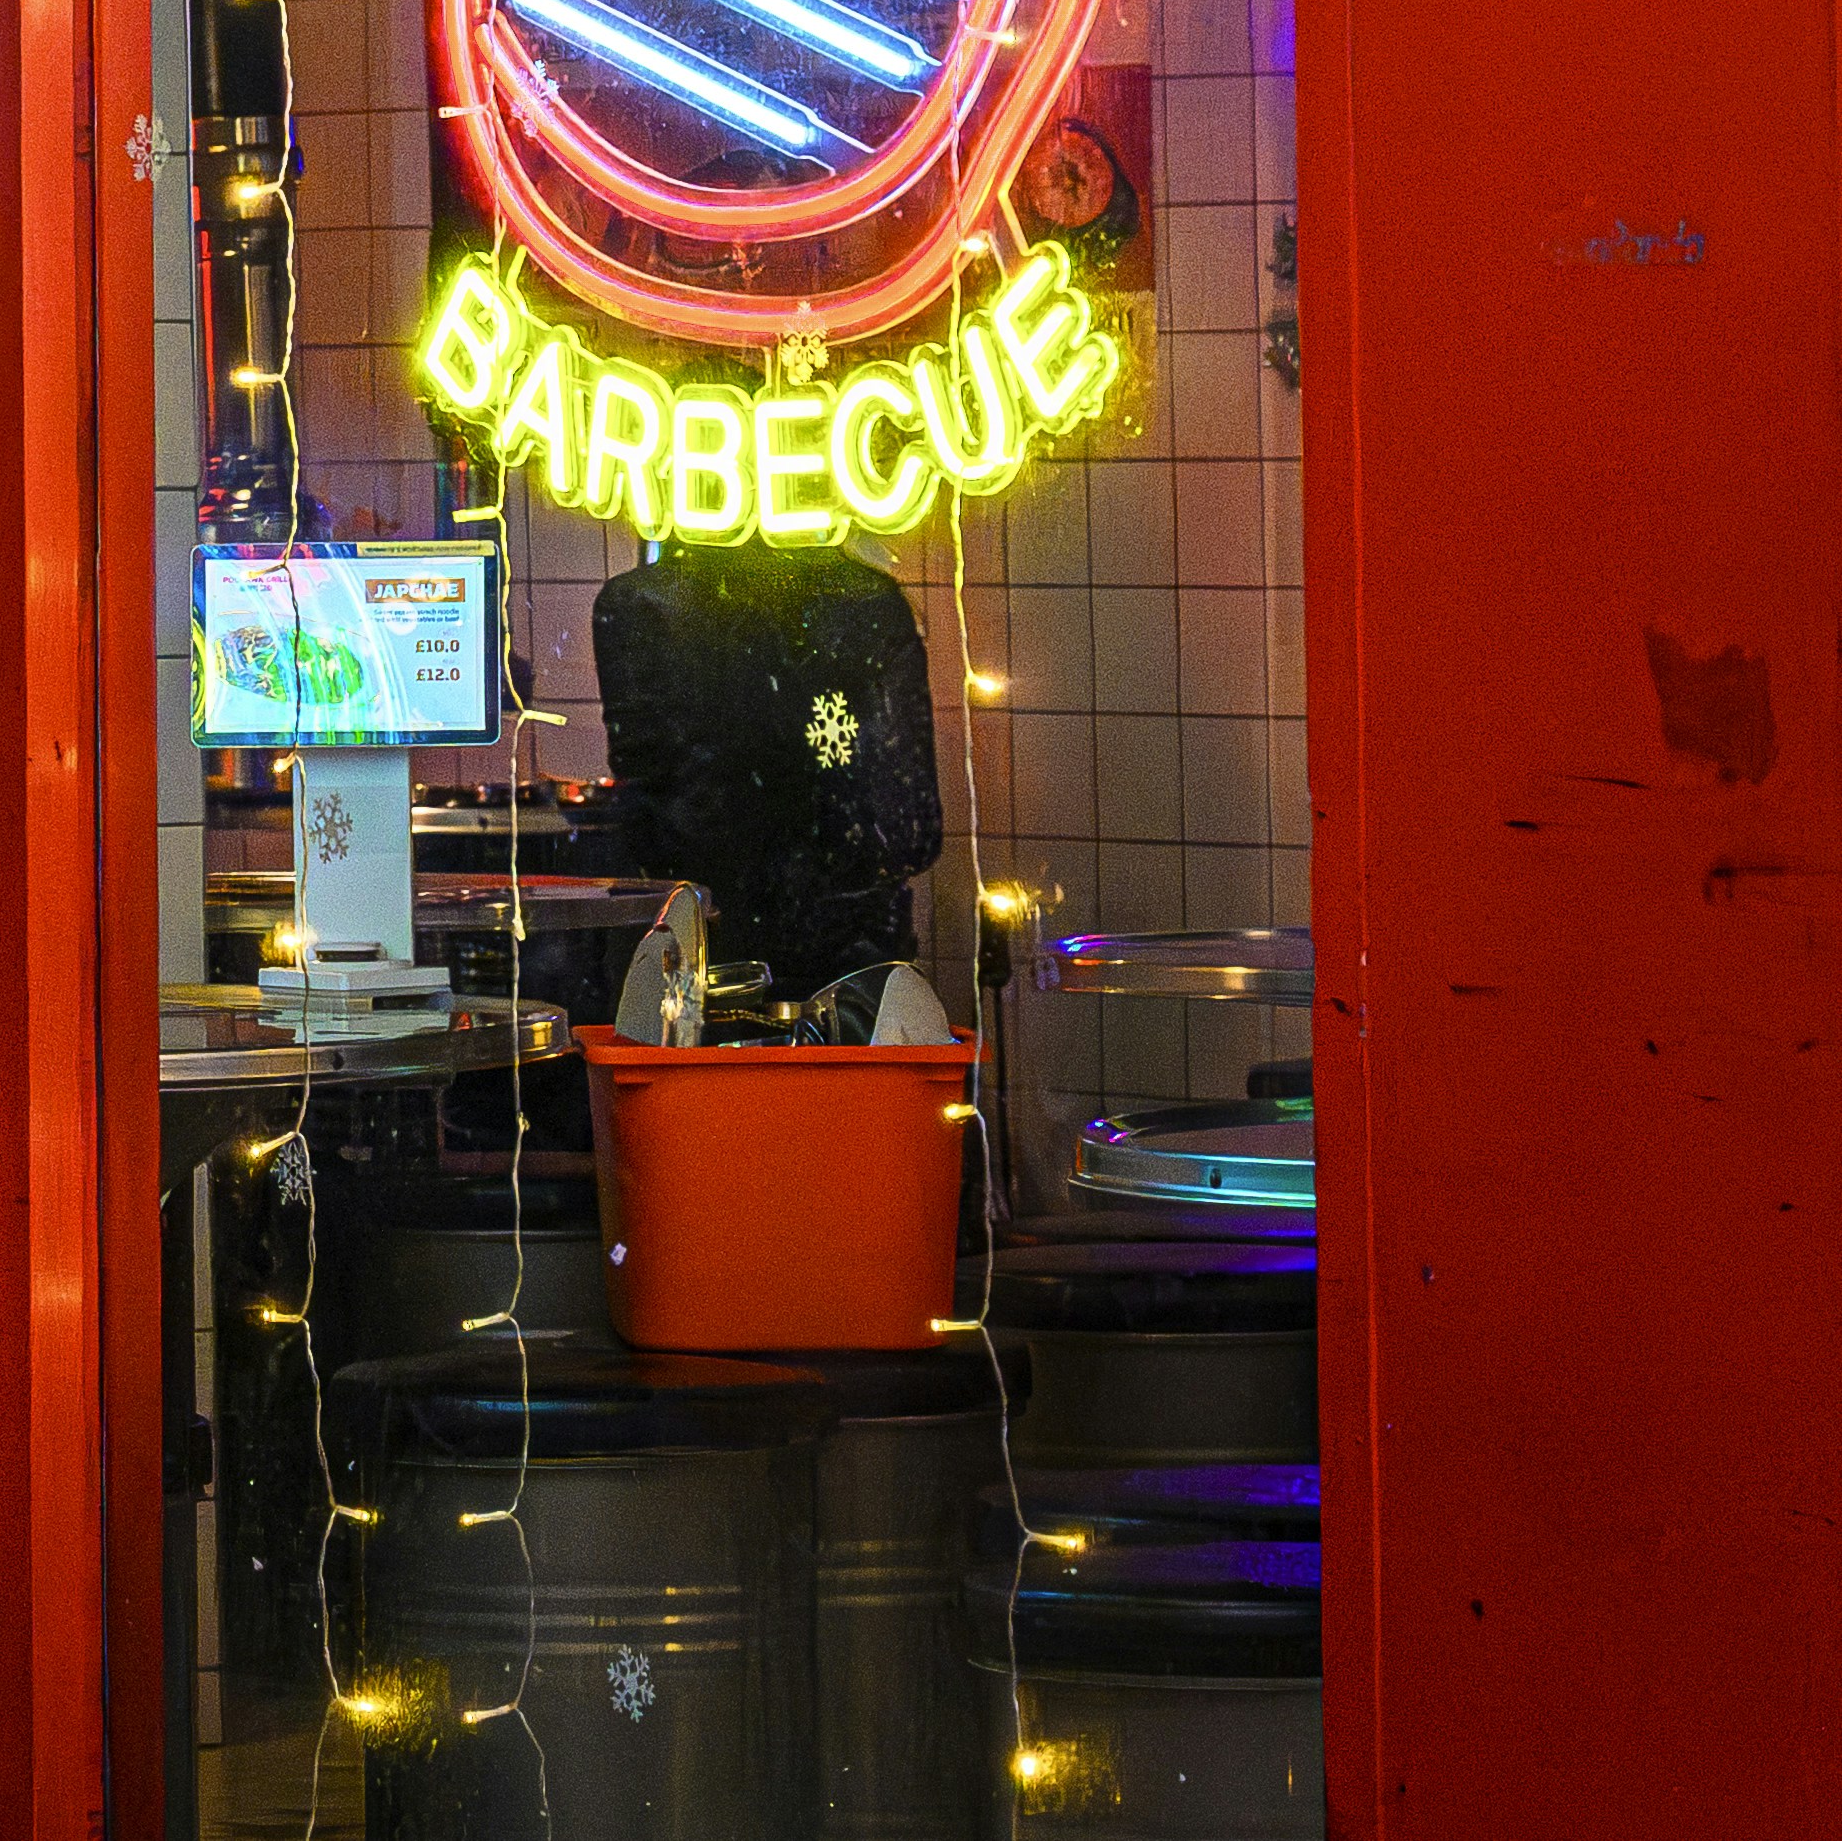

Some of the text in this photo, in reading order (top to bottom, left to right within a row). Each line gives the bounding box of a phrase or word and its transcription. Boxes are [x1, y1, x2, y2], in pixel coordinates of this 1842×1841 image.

[420, 243, 1118, 546] BARBECUE
[374, 581, 460, 600] JAPCHAE
[415, 639, 461, 654] £10.0
[416, 668, 461, 682] £12.0
